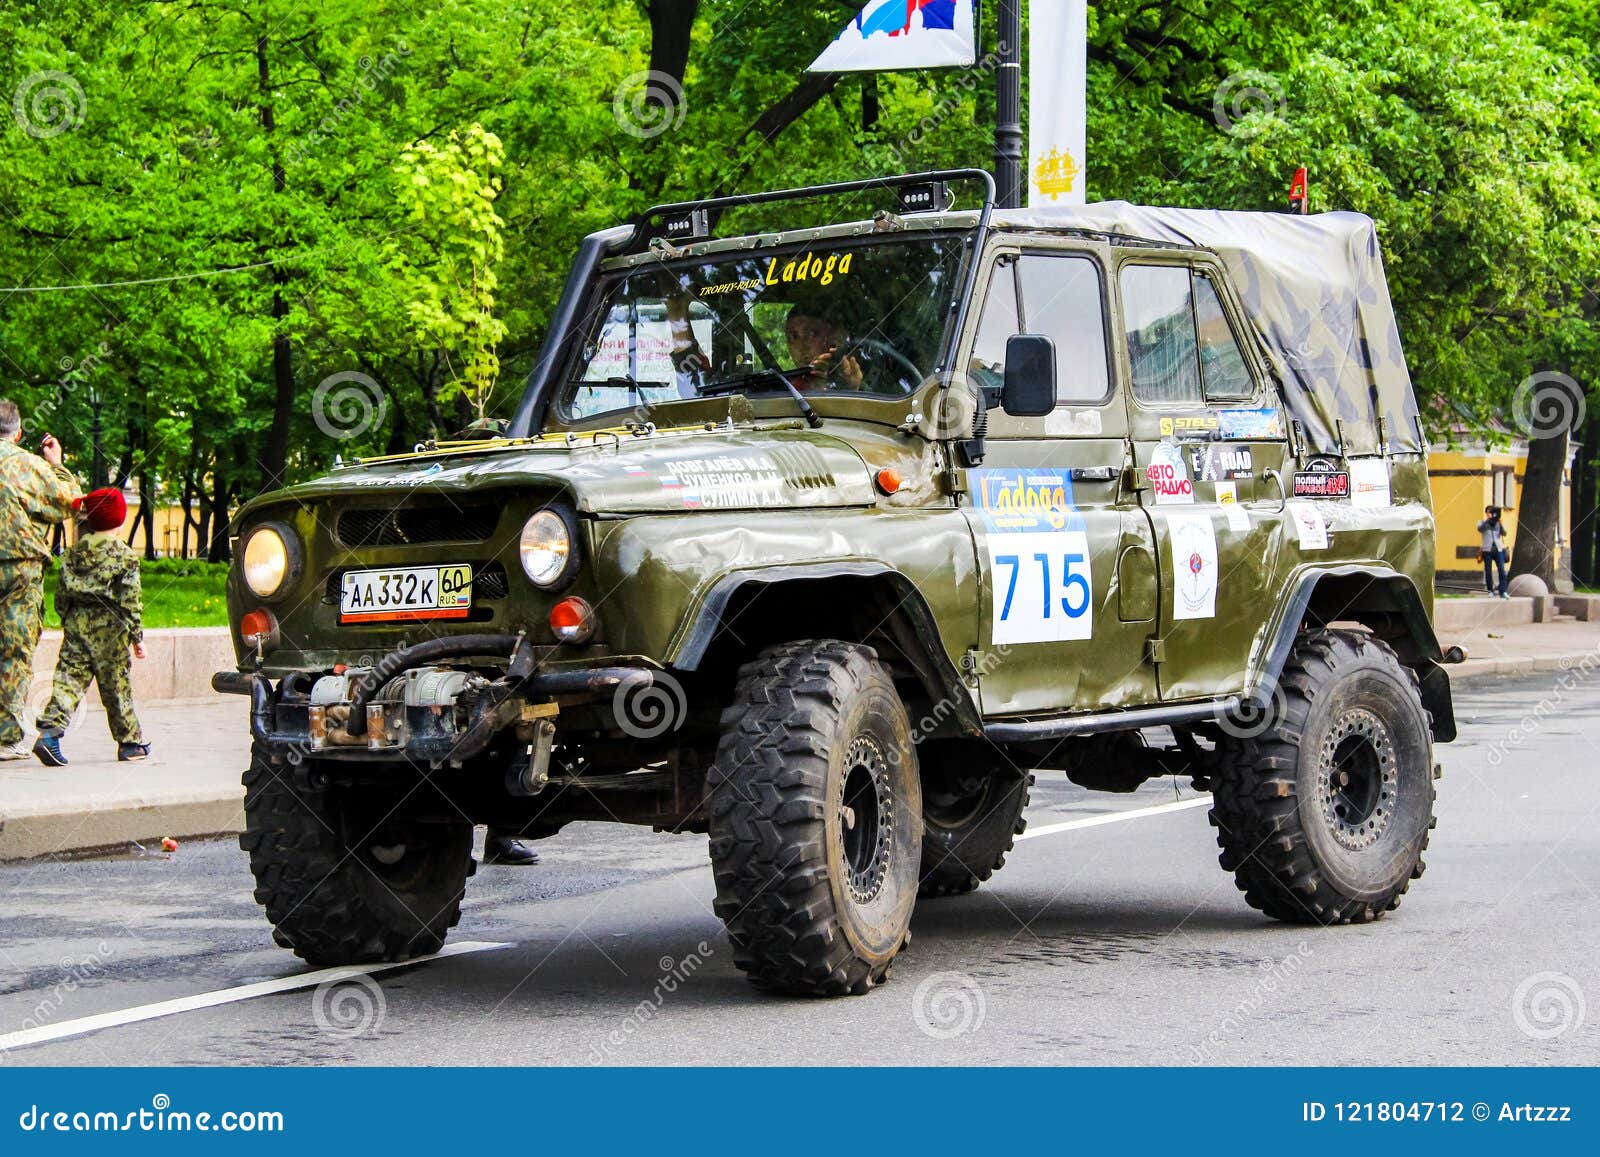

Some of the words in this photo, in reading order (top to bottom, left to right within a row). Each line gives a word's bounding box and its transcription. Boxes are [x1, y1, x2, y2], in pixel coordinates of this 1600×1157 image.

[699, 278, 761, 297] TROPHY-RAID
[765, 251, 853, 287] Ladoga
[1175, 417, 1217, 428] STELS
[664, 456, 743, 479] ДОВГАЛЁВ
[1147, 464, 1175, 480] АВТО
[700, 488, 760, 508] СУЛИМА
[1154, 479, 1193, 496] РАДИО
[981, 475, 1067, 529] Ladoga
[441, 569, 464, 593] 60
[994, 553, 1090, 621] 715
[440, 595, 456, 603] RUS
